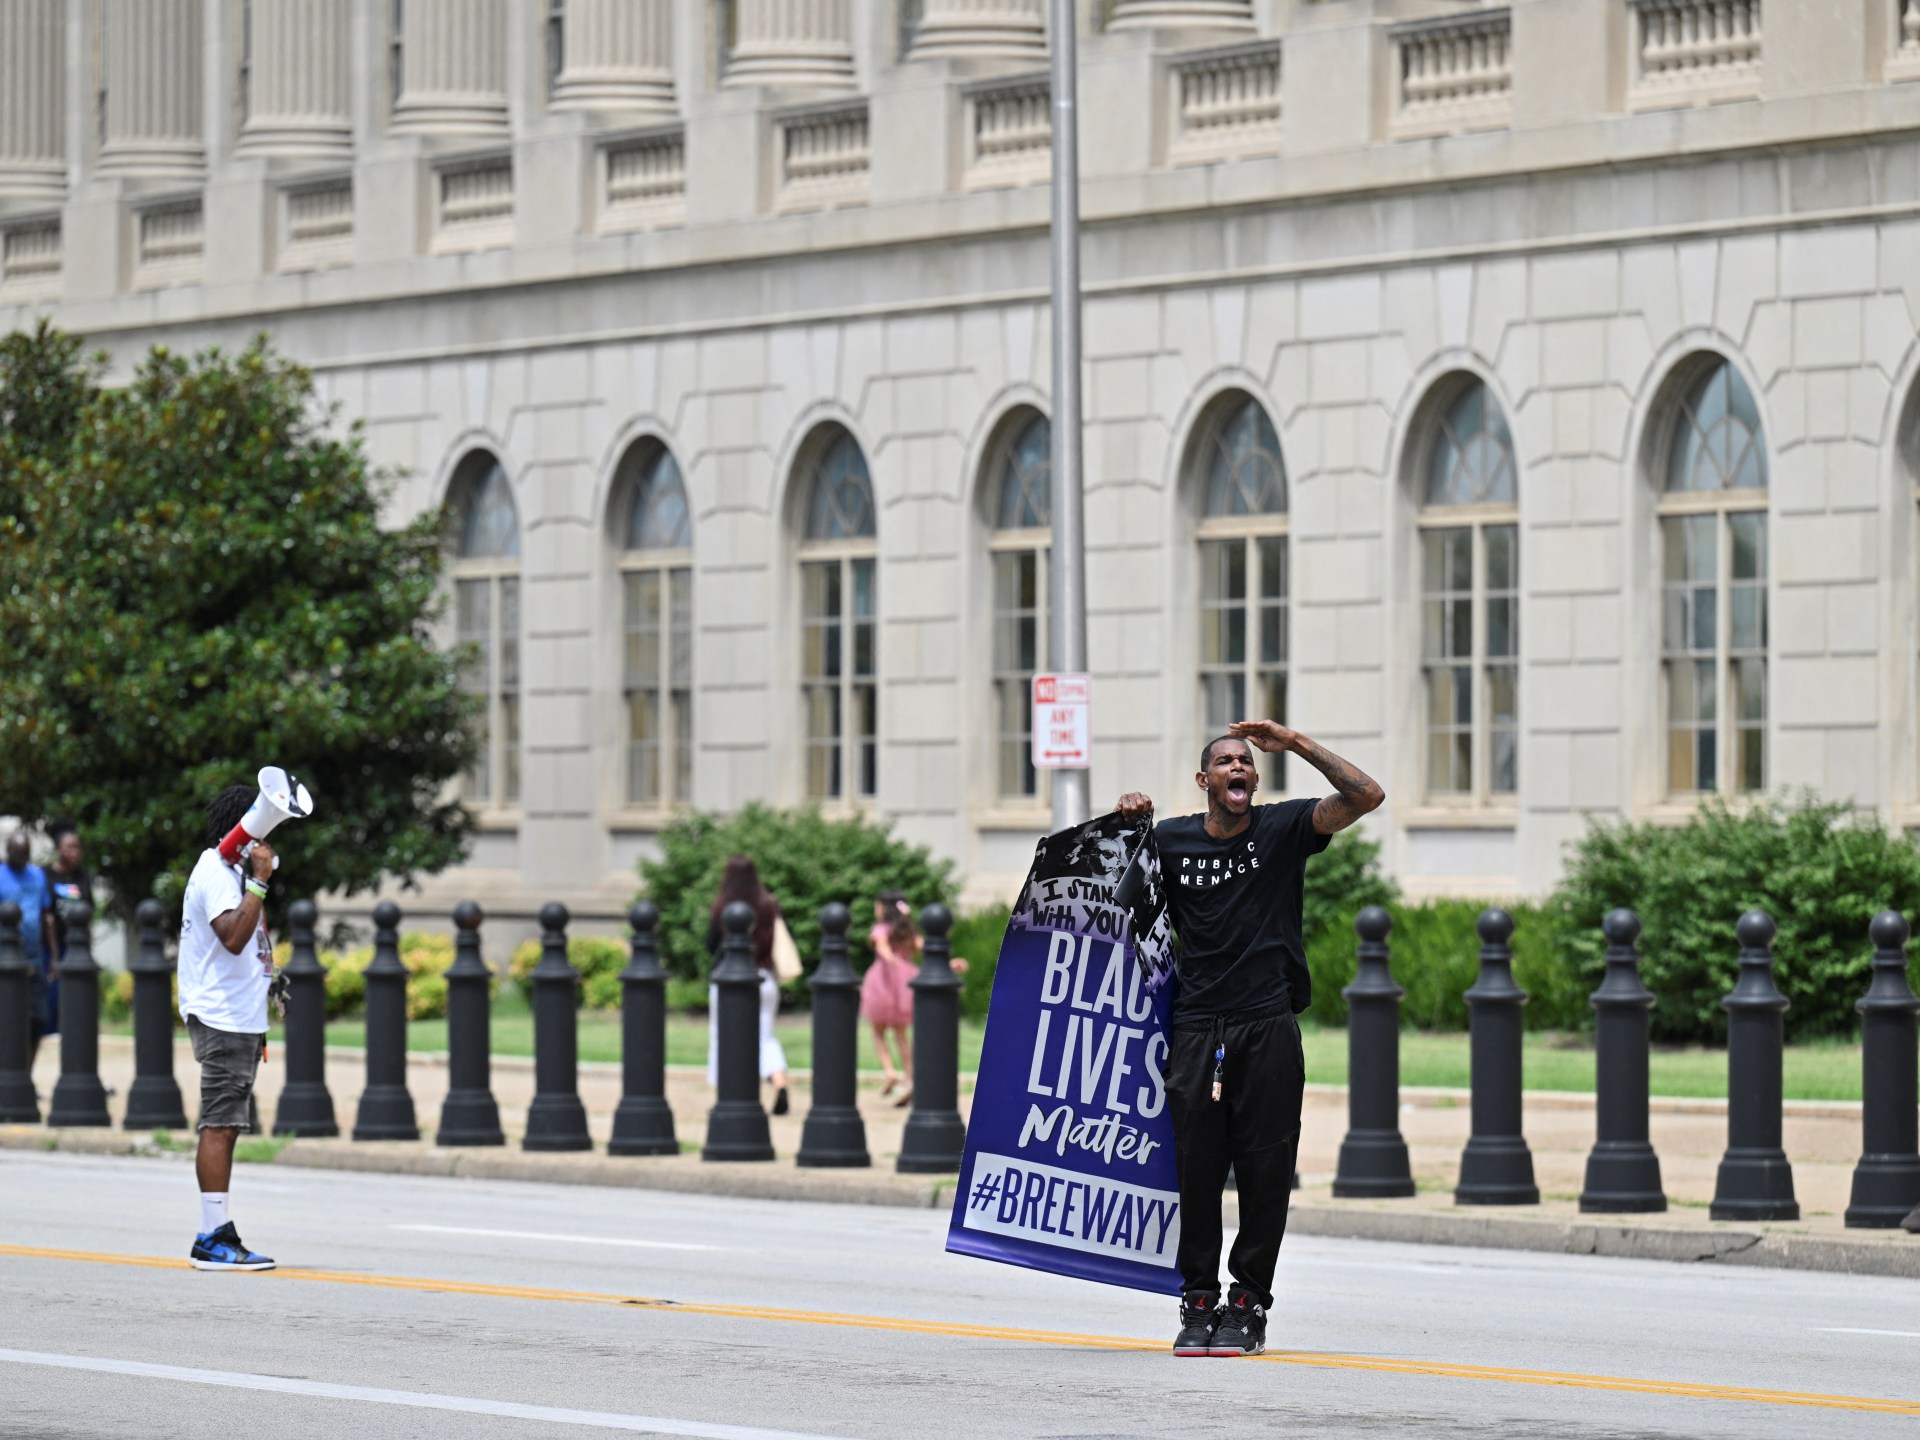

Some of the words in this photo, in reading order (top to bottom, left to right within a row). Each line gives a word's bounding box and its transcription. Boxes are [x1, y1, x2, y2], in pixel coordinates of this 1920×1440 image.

[1050, 709, 1075, 725] ANY
[1050, 729, 1076, 746] TIME
[1182, 842, 1255, 869] PUBLC
[1180, 858, 1259, 886] MENACE
[1042, 879, 1063, 902] I
[1031, 905, 1076, 931] With
[1081, 905, 1125, 940] YOU
[1040, 930, 1160, 1025] BLAC
[1027, 1009, 1170, 1119] LIVES
[1018, 1103, 1161, 1165] Matter
[971, 1167, 1179, 1255] #BREEWAYY
